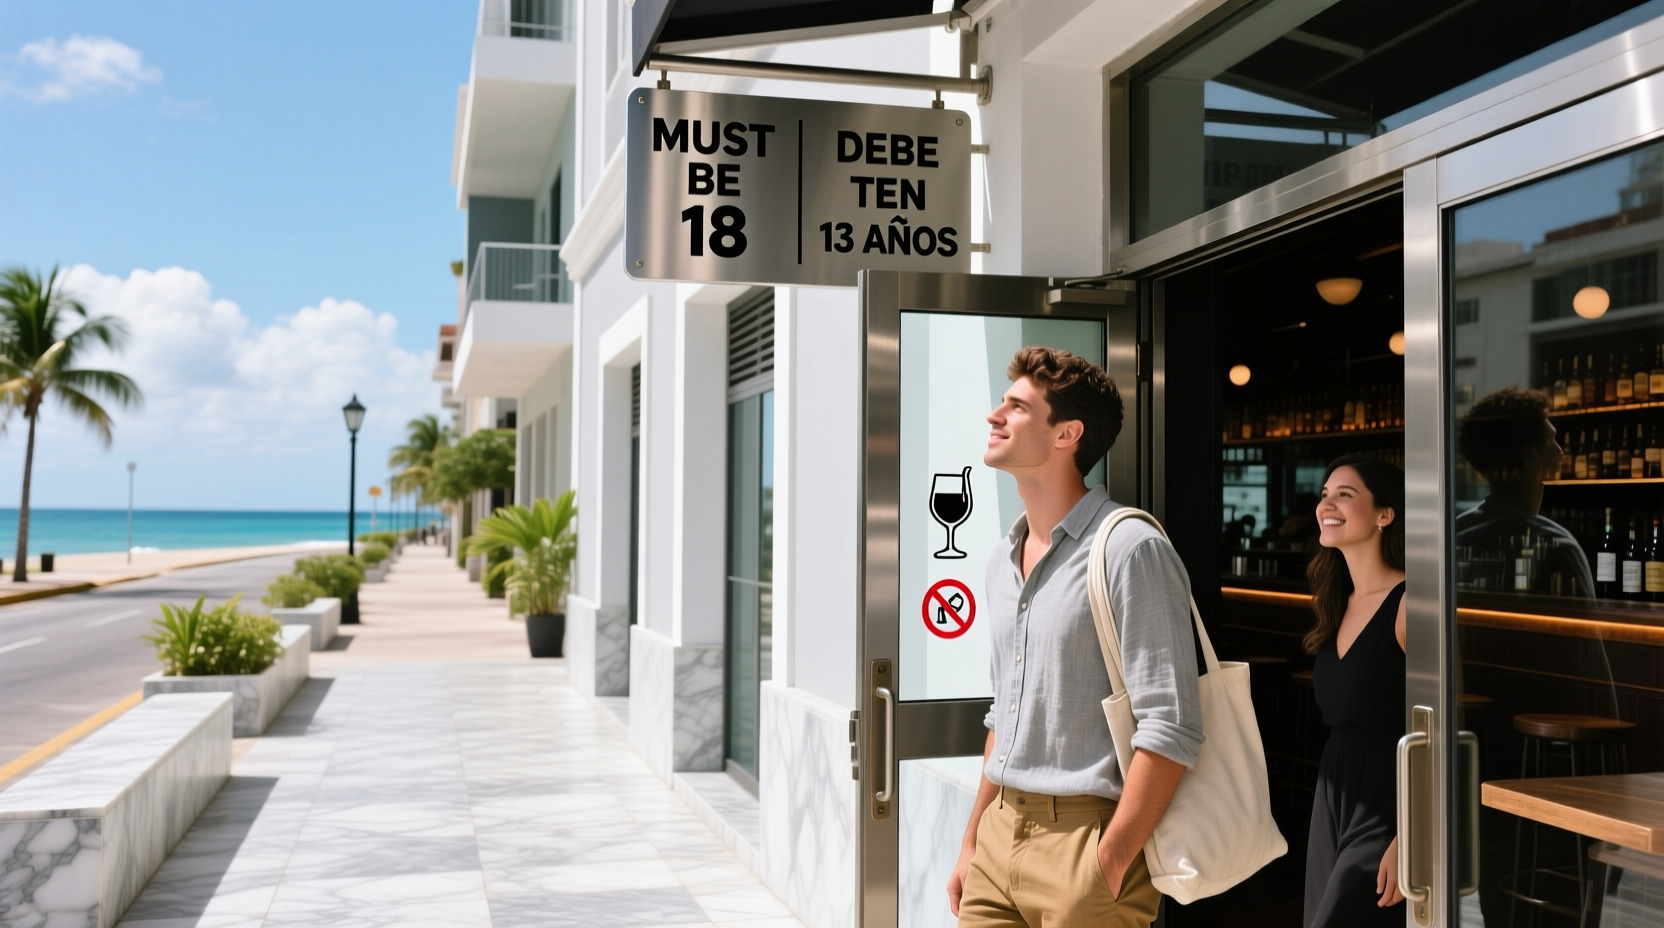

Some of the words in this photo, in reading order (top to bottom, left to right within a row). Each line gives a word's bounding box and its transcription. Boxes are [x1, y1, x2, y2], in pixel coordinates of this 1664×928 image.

[653, 117, 775, 158] MUST
[837, 130, 939, 168] DEBE
[688, 162, 741, 197] BE
[850, 175, 926, 211] TEN
[681, 204, 748, 259] 18
[819, 221, 854, 254] 13
[862, 215, 959, 258] AÑOS
